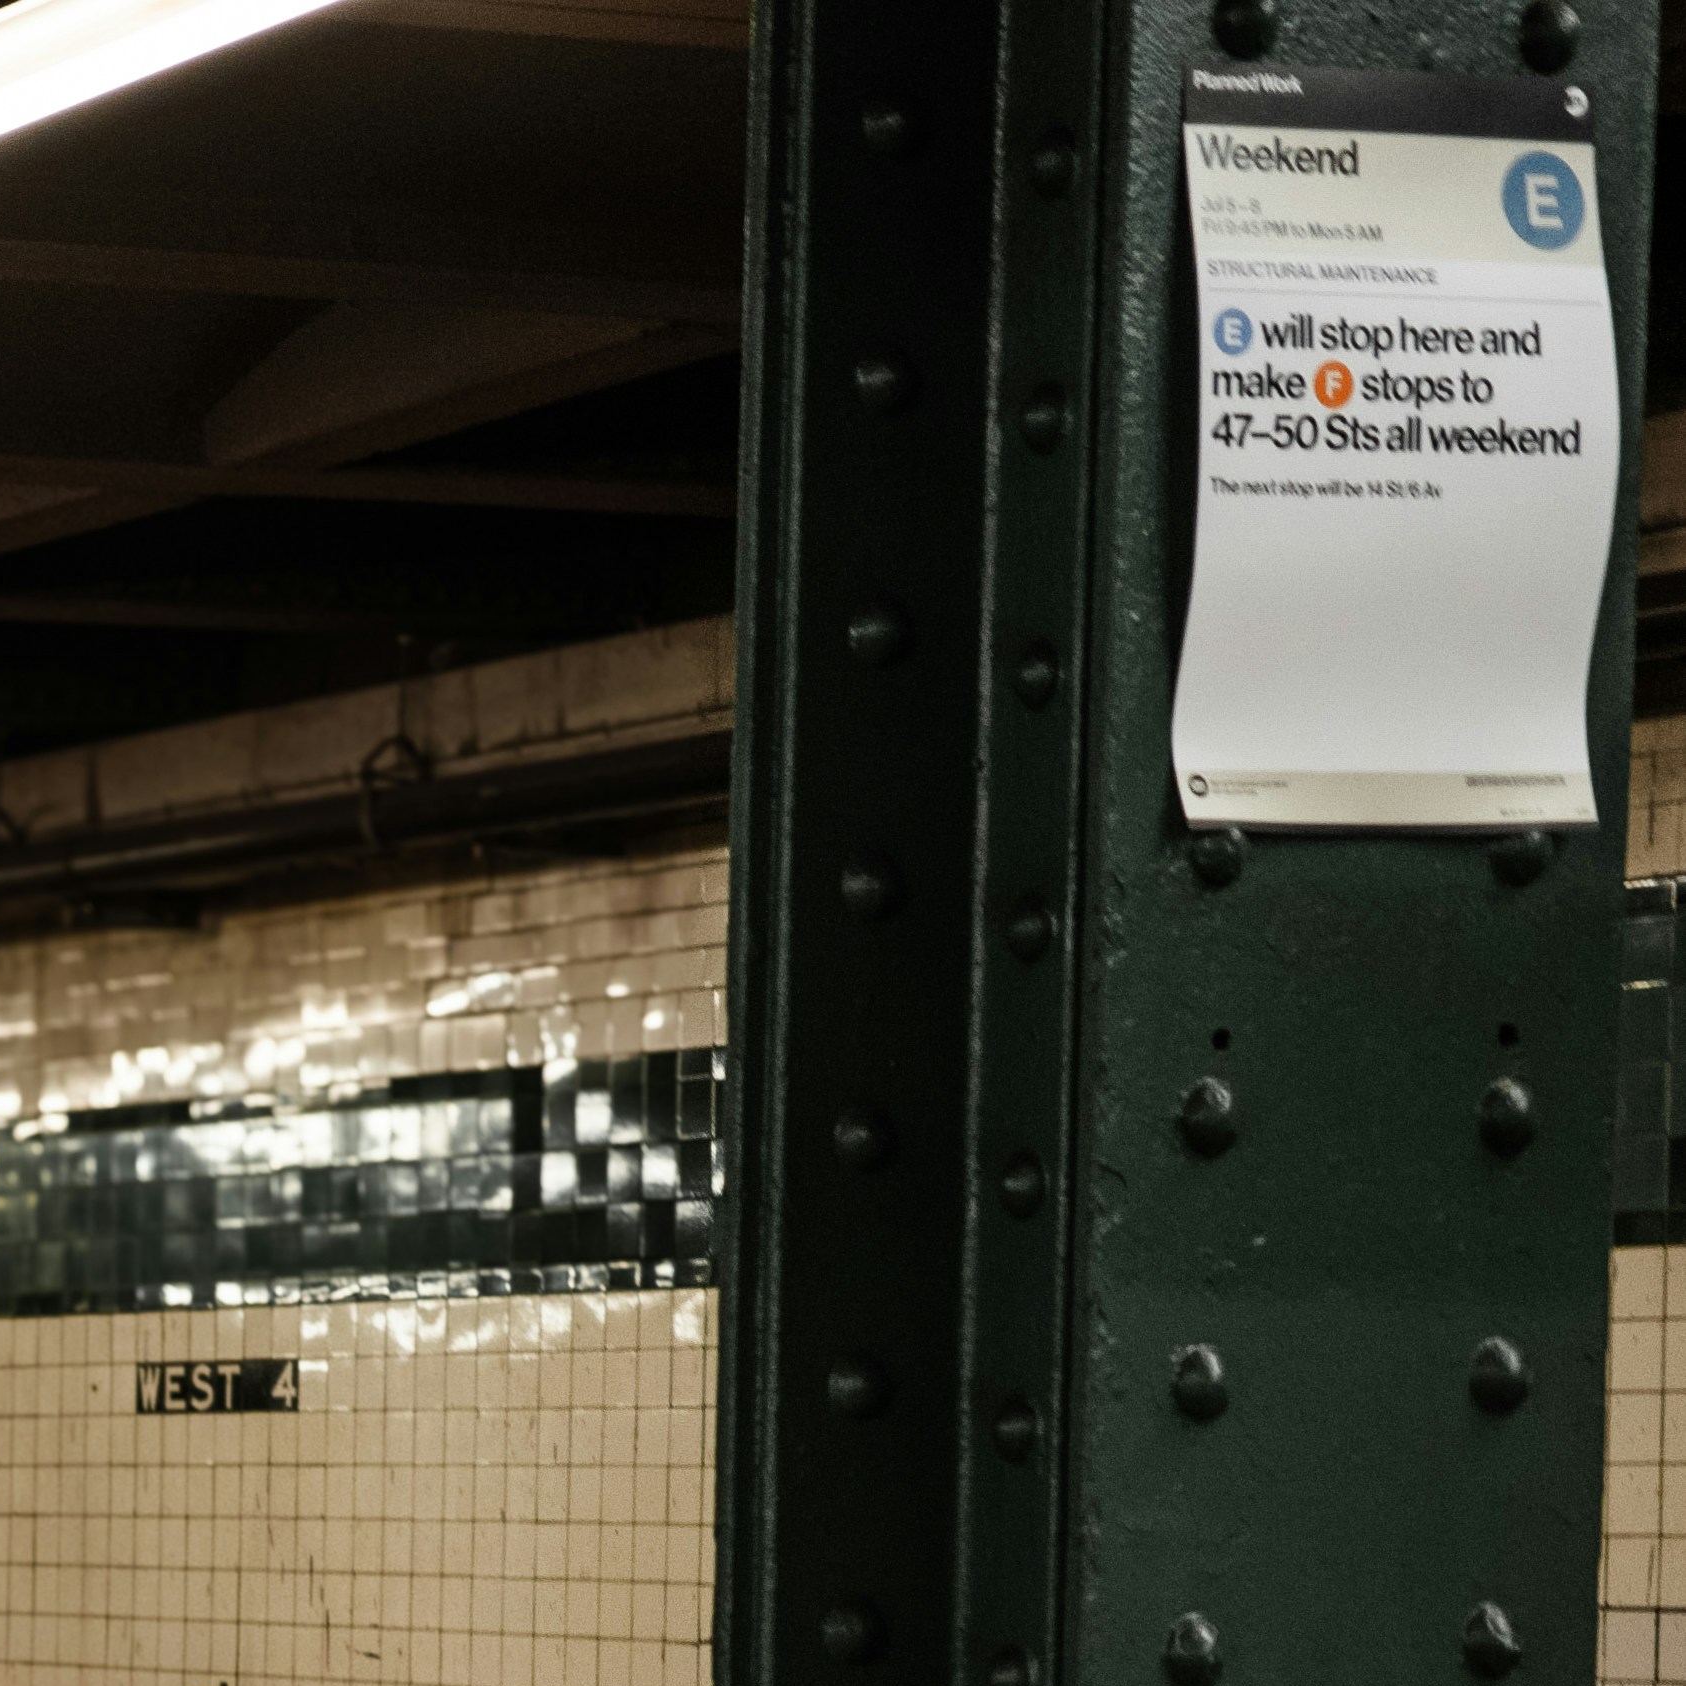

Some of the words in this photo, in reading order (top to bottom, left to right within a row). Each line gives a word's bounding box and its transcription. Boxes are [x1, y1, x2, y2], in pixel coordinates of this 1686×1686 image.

[1193, 69, 1259, 92] Planned
[1259, 72, 1304, 96] Work
[1195, 132, 1359, 177] Weekend
[1524, 173, 1564, 229] E
[1357, 223, 1384, 243] AM
[1206, 259, 1316, 280] STRUCTURAL
[1318, 262, 1439, 285] MAINTENANCE
[1261, 312, 1314, 349] will
[1320, 315, 1394, 359] stop
[1399, 316, 1475, 354] here
[1480, 320, 1542, 356] and
[1212, 363, 1307, 398] make
[1361, 367, 1455, 410] stops
[1460, 368, 1494, 403] to
[1323, 413, 1380, 451] Sts
[1386, 416, 1422, 452] all
[1428, 417, 1581, 457] weekend
[1209, 475, 1240, 495] The
[1242, 478, 1276, 496] next
[1279, 478, 1314, 500] stop
[138, 1364, 241, 1411] WEST
[271, 1361, 298, 1408] 4
